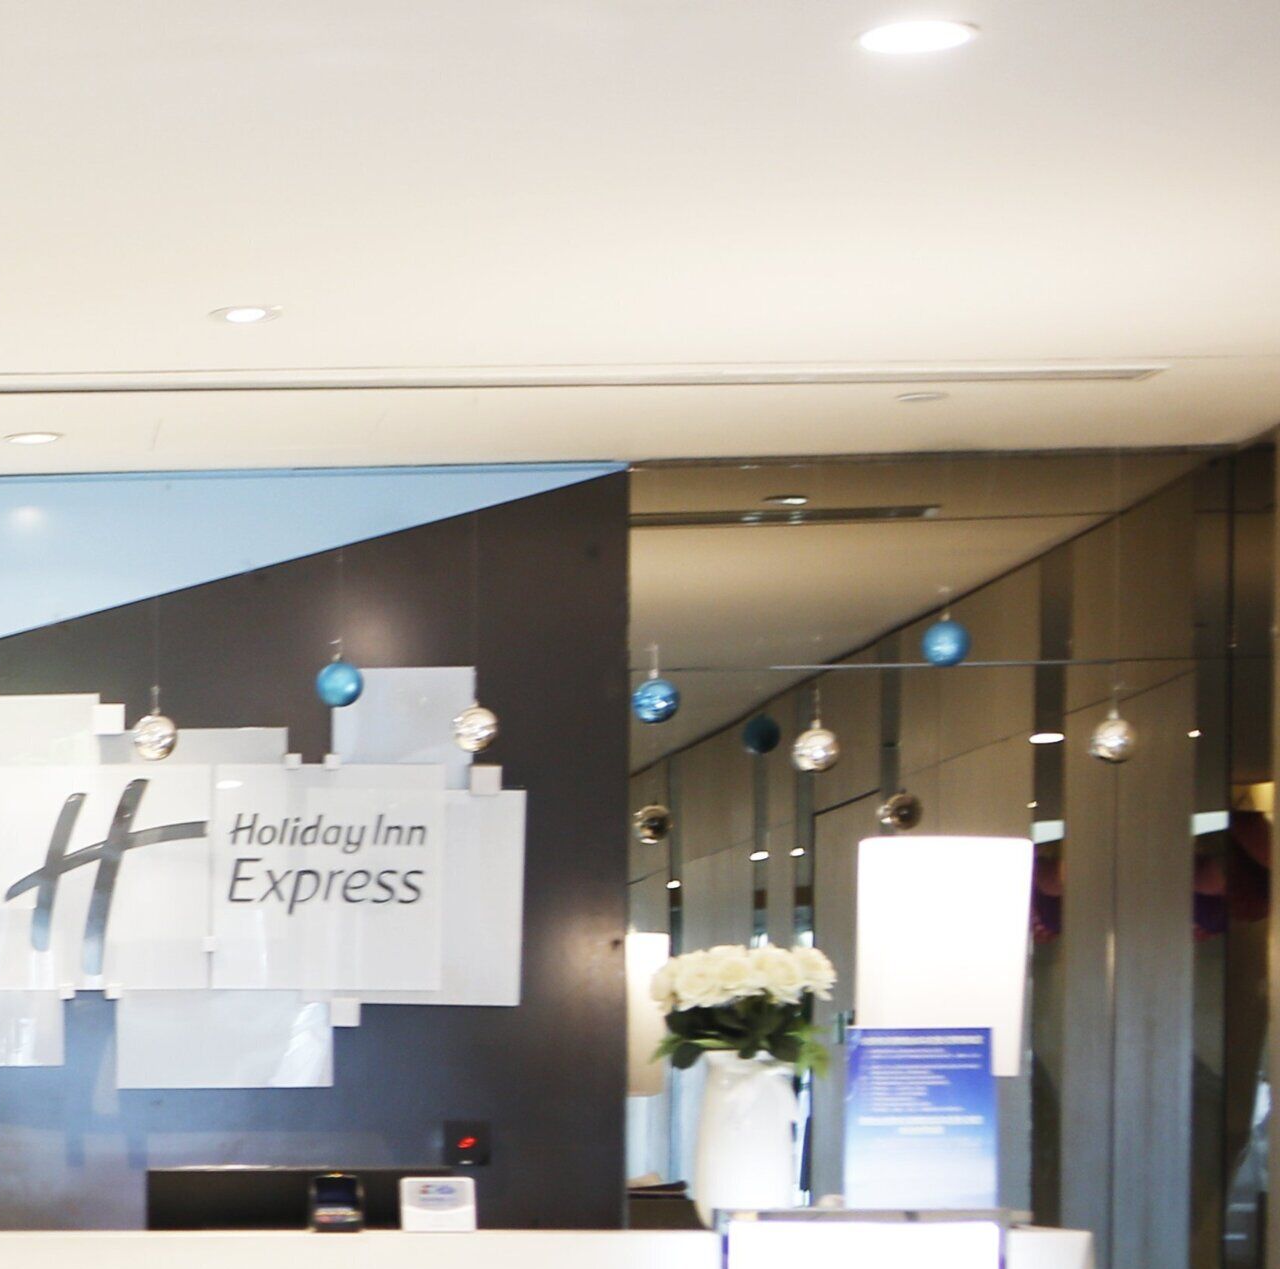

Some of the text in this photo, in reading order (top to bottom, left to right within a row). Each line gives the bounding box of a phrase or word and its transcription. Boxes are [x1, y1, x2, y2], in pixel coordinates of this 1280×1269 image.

[229, 812, 428, 855] Holiday Inn
[227, 857, 426, 915] Express
